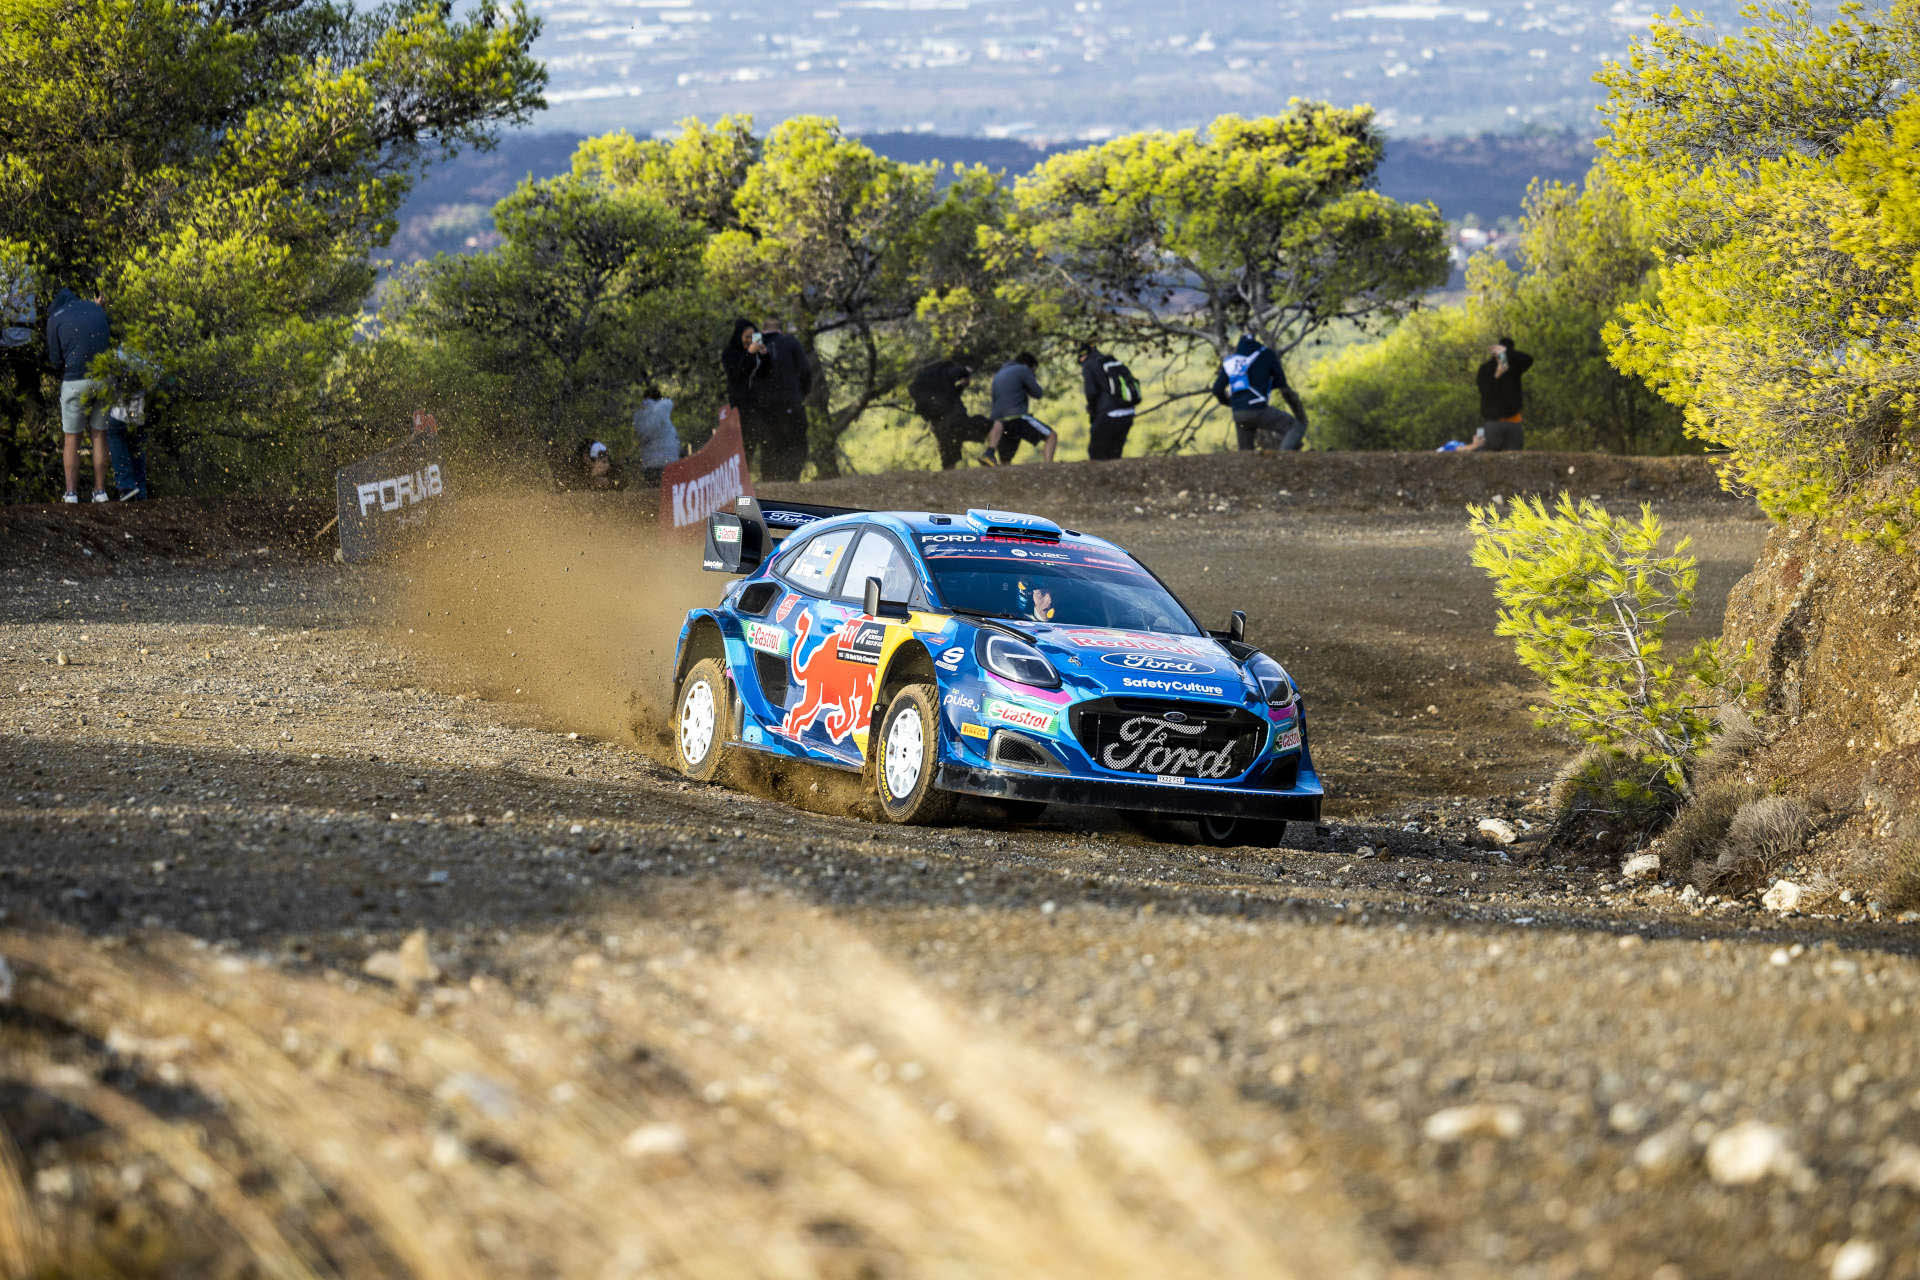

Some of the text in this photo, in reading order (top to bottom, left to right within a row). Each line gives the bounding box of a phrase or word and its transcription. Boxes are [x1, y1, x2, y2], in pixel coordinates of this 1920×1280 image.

[357, 464, 443, 517] FORUM8
[921, 534, 977, 543] FORD
[980, 535, 1121, 555] PERFORMAN
[1028, 551, 1071, 561] WRC
[754, 626, 780, 650] Castrol
[1070, 637, 1140, 649] Red
[1123, 654, 1197, 672] Ford
[1122, 677, 1224, 696] SafetyCulture
[943, 694, 974, 708] pulse
[1001, 707, 1049, 729] Castrol
[1103, 716, 1238, 779] Ford
